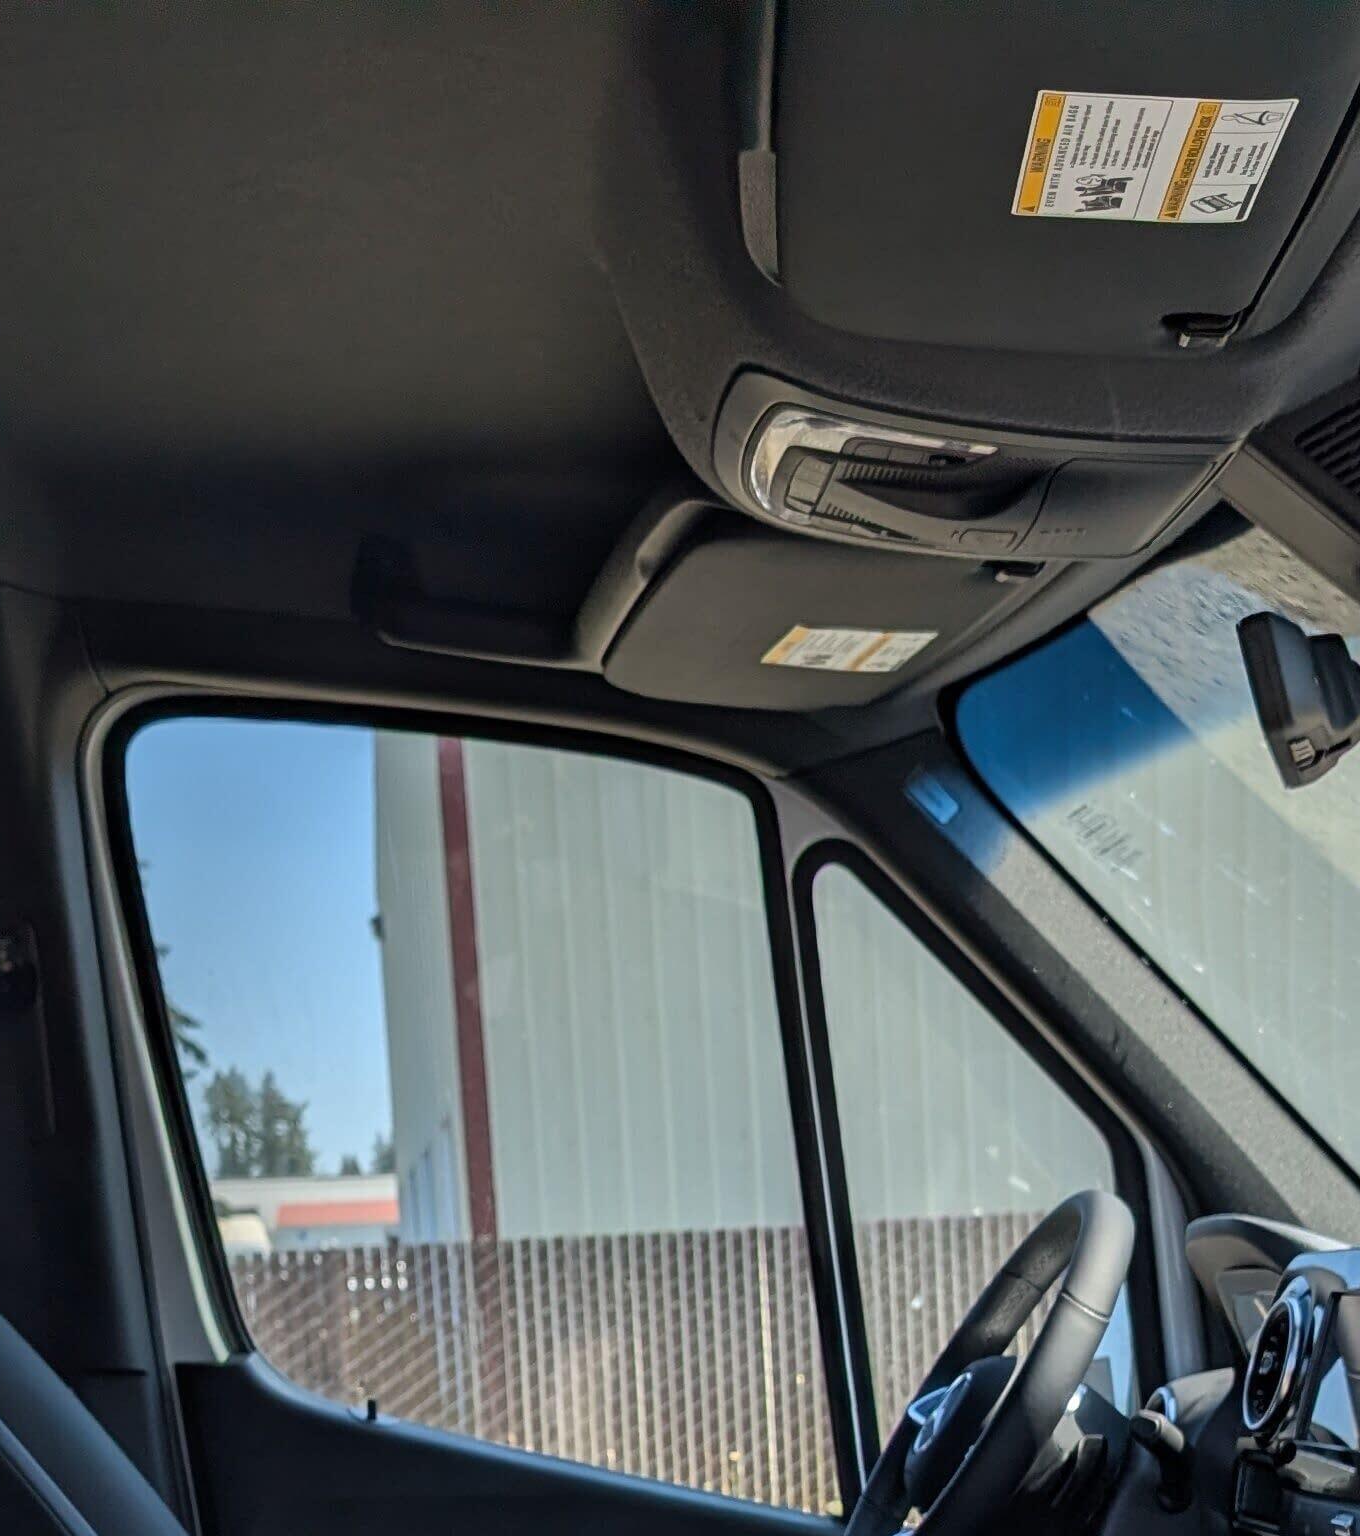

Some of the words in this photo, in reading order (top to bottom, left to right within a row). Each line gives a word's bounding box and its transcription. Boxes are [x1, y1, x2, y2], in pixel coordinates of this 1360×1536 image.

[1066, 104, 1079, 122] BAGS
[1062, 124, 1074, 136] AIR
[1030, 138, 1051, 173] WARNING
[1053, 137, 1070, 171] ADVANCED
[1049, 173, 1061, 190] WITH
[1044, 191, 1056, 208] EVEN
